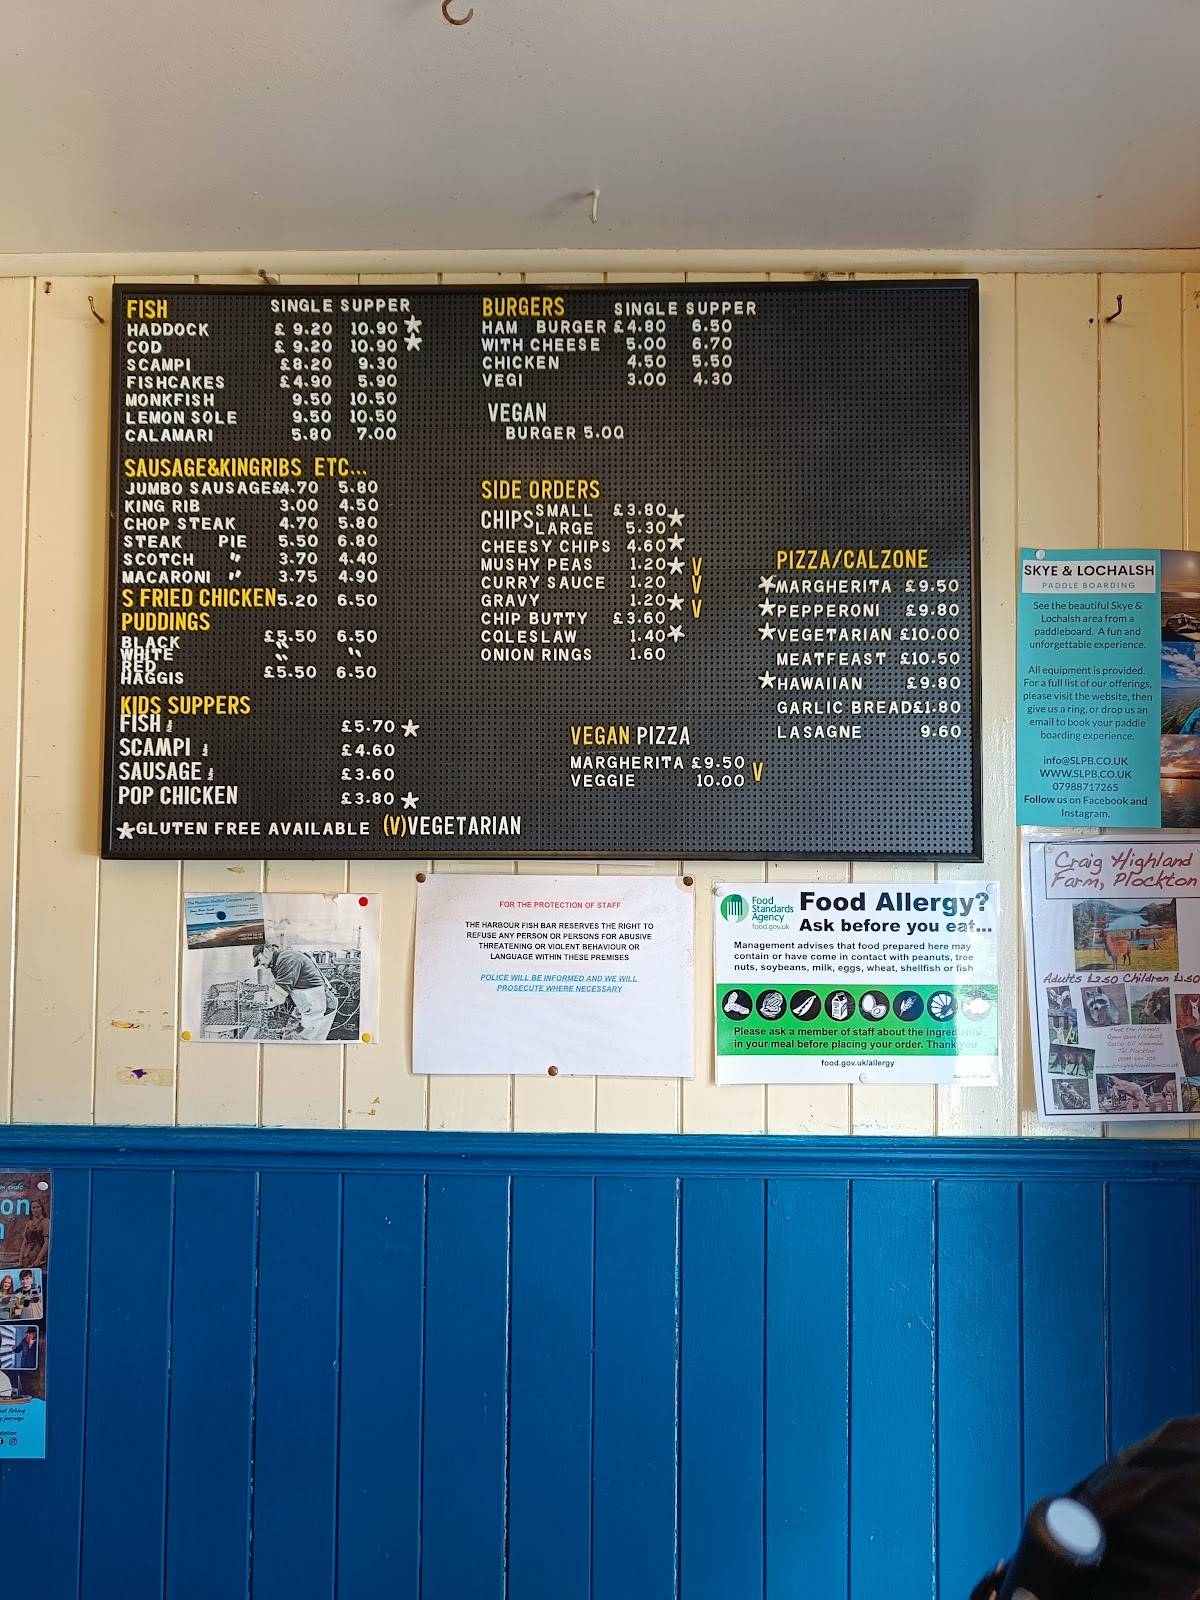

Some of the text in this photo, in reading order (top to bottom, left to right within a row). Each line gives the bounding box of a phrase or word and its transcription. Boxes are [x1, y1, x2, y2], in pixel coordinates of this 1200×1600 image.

[127, 299, 168, 319] FISH
[270, 298, 410, 313] SINGLE SUPPER
[482, 296, 565, 317] BURGERS
[614, 300, 756, 317] SINGLE SUPPER
[482, 318, 733, 335] HAM BURGER £4.80 6.50
[481, 336, 733, 353] WITH CHEESE 5.00 6.70
[126, 356, 398, 372] SCAMPI £8.20 9.30
[482, 354, 733, 370] CHICKEN 4.50 5.50
[125, 409, 397, 425] LEMON SOLE 9.50 10.50
[487, 402, 547, 423] VEGAN
[124, 426, 397, 443] CALAMARI 5.80 7.00
[505, 425, 576, 441] BURGER
[124, 457, 367, 478] SAUSAGE&KINGRIBS ETC...
[481, 479, 600, 500] SIDE ORDERS
[535, 502, 667, 518] SMALL £3.80
[480, 509, 534, 530] CHIPS
[123, 533, 378, 549] STEAK PIE 5.50 6.80
[481, 538, 667, 554] CHEESY CHIPS 4.60
[777, 549, 928, 570] PIZZA/CALZONE
[122, 569, 378, 584] MACARONI 3.75 4.90
[1024, 565, 1155, 576] SKYE & LOCHALSH
[773, 579, 959, 594] MARGHERITA £9.50
[121, 587, 378, 608] S FRIED CHICKEN 5.20 6.50
[1033, 601, 1142, 611] See the beautiful Skye &
[121, 611, 211, 632] PUDDINGS
[480, 611, 666, 626] CHIP BUTTY £3.60
[777, 627, 960, 642] VEGETARIAN £10.00
[776, 651, 960, 666] MEATFEAST £10.50
[120, 665, 377, 686] HAGGIS £5.50 6.50
[777, 676, 961, 691] HAWAIIAN £9.80
[120, 695, 251, 715] KIDS SUPPERS
[570, 725, 690, 746] VEGAN PIZZA
[777, 724, 962, 739] LASAGNE 9.60
[570, 755, 745, 770] MARGHERITA £9.50
[1043, 756, 1129, 766] info@SLPB.CO.UK
[570, 773, 745, 788] VEGGIE 10.00
[1039, 769, 1132, 779] WWW.SLPB.CO.UK
[118, 785, 395, 806] POP CHICKEN £3.80
[1053, 783, 1119, 792] 07988717265
[1061, 809, 1110, 819] Instagram.
[214, 821, 261, 836] FREE
[268, 821, 370, 836] AVAILABLE
[1055, 848, 1193, 875] Craig Highland
[1051, 868, 1197, 890] Farm, Plockton
[751, 896, 774, 905] Food
[800, 892, 989, 916] Food Allergy?
[751, 905, 794, 913] Standards
[465, 921, 480, 929] THE
[482, 921, 520, 929] HARBOUR
[541, 922, 557, 930] BAR
[558, 922, 599, 930] RESERVES
[601, 922, 617, 930] THE
[751, 913, 785, 923] Agency
[752, 923, 789, 931] food.gov.uk
[800, 919, 992, 935] Ask before you eat...
[734, 941, 795, 951] Management
[797, 942, 834, 950] advises
[837, 942, 856, 950] that
[858, 942, 880, 950] food
[882, 942, 925, 951] prepared
[1043, 973, 1082, 984] Adults
[1123, 973, 1169, 983] Children
[821, 1059, 895, 1068] food.gov.uk/allergy
